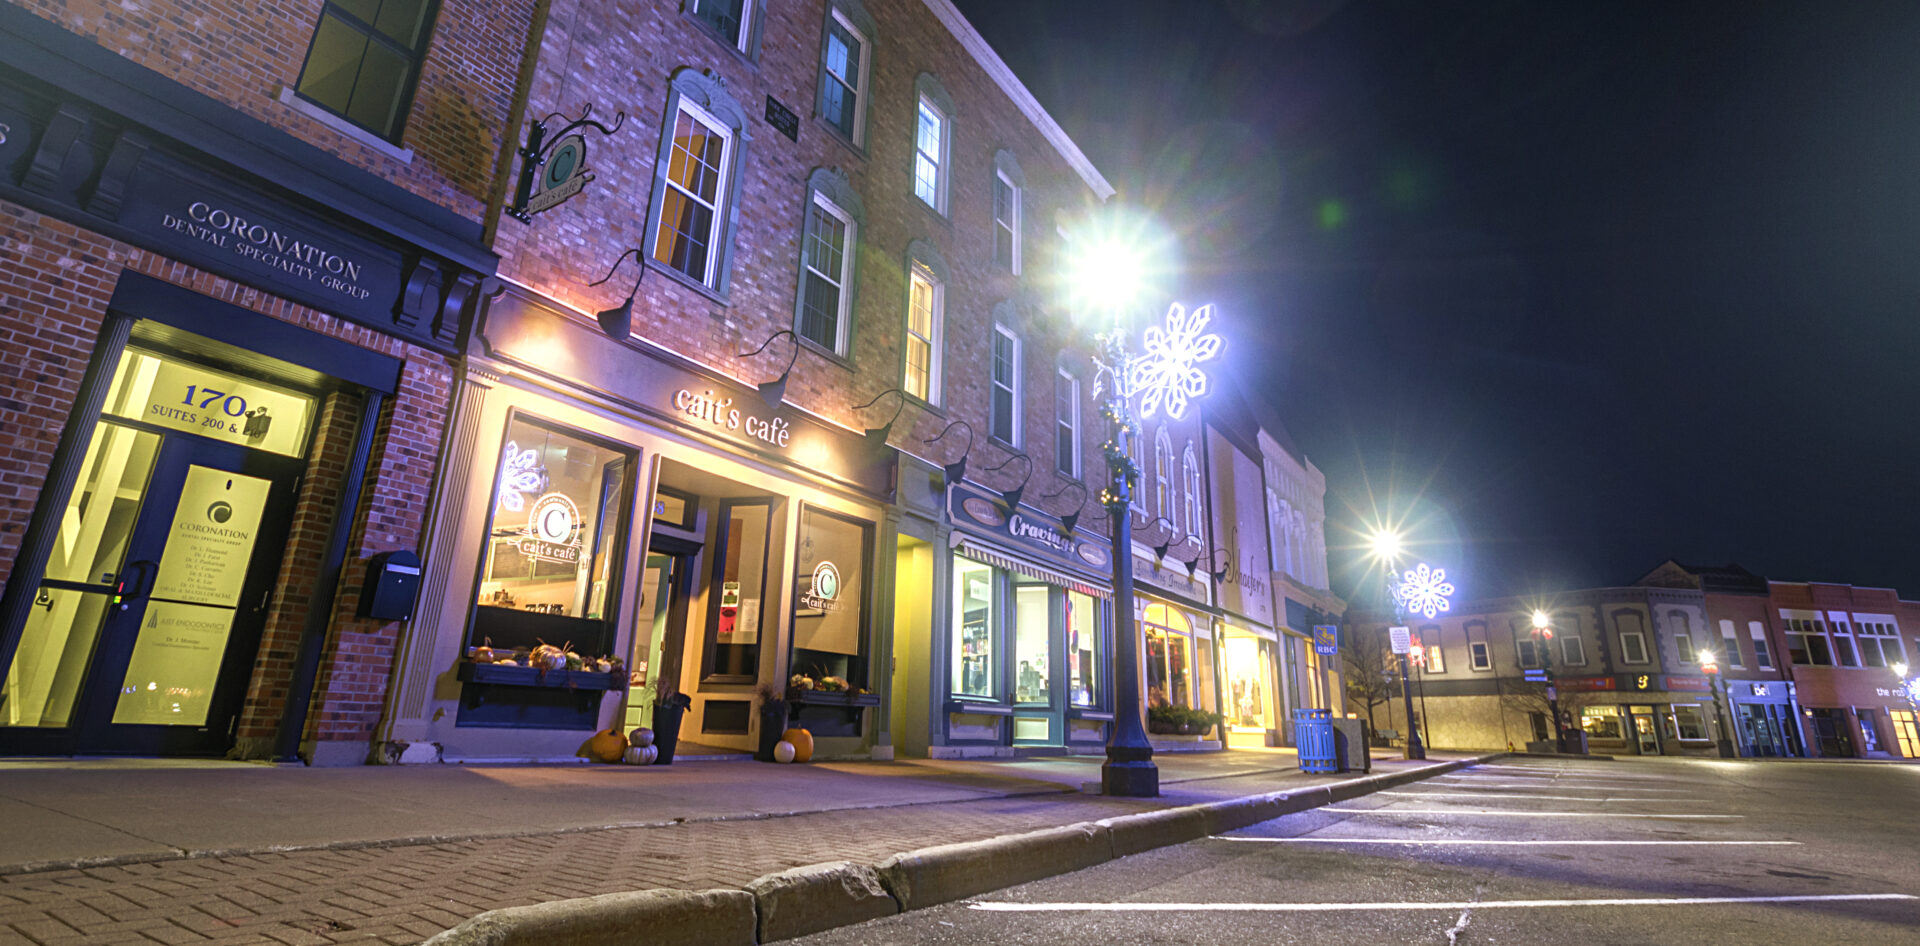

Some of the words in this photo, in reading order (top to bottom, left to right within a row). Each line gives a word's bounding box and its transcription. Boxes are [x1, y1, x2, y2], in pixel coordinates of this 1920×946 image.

[162, 214, 228, 248] DENTAL
[235, 242, 318, 281] SPECIALTY
[320, 275, 370, 300] GROUP
[188, 201, 361, 282] CORONATION
[181, 385, 247, 417] 170
[151, 404, 197, 423] SUITES
[201, 416, 225, 430] 200
[228, 423, 238, 433] &
[677, 389, 740, 430] cait's
[745, 416, 790, 448] café
[180, 522, 249, 540] CORONATION
[1009, 514, 1076, 553] Cravings
[523, 540, 552, 556] cait's
[553, 547, 575, 560] café
[1876, 687, 1890, 697] the
